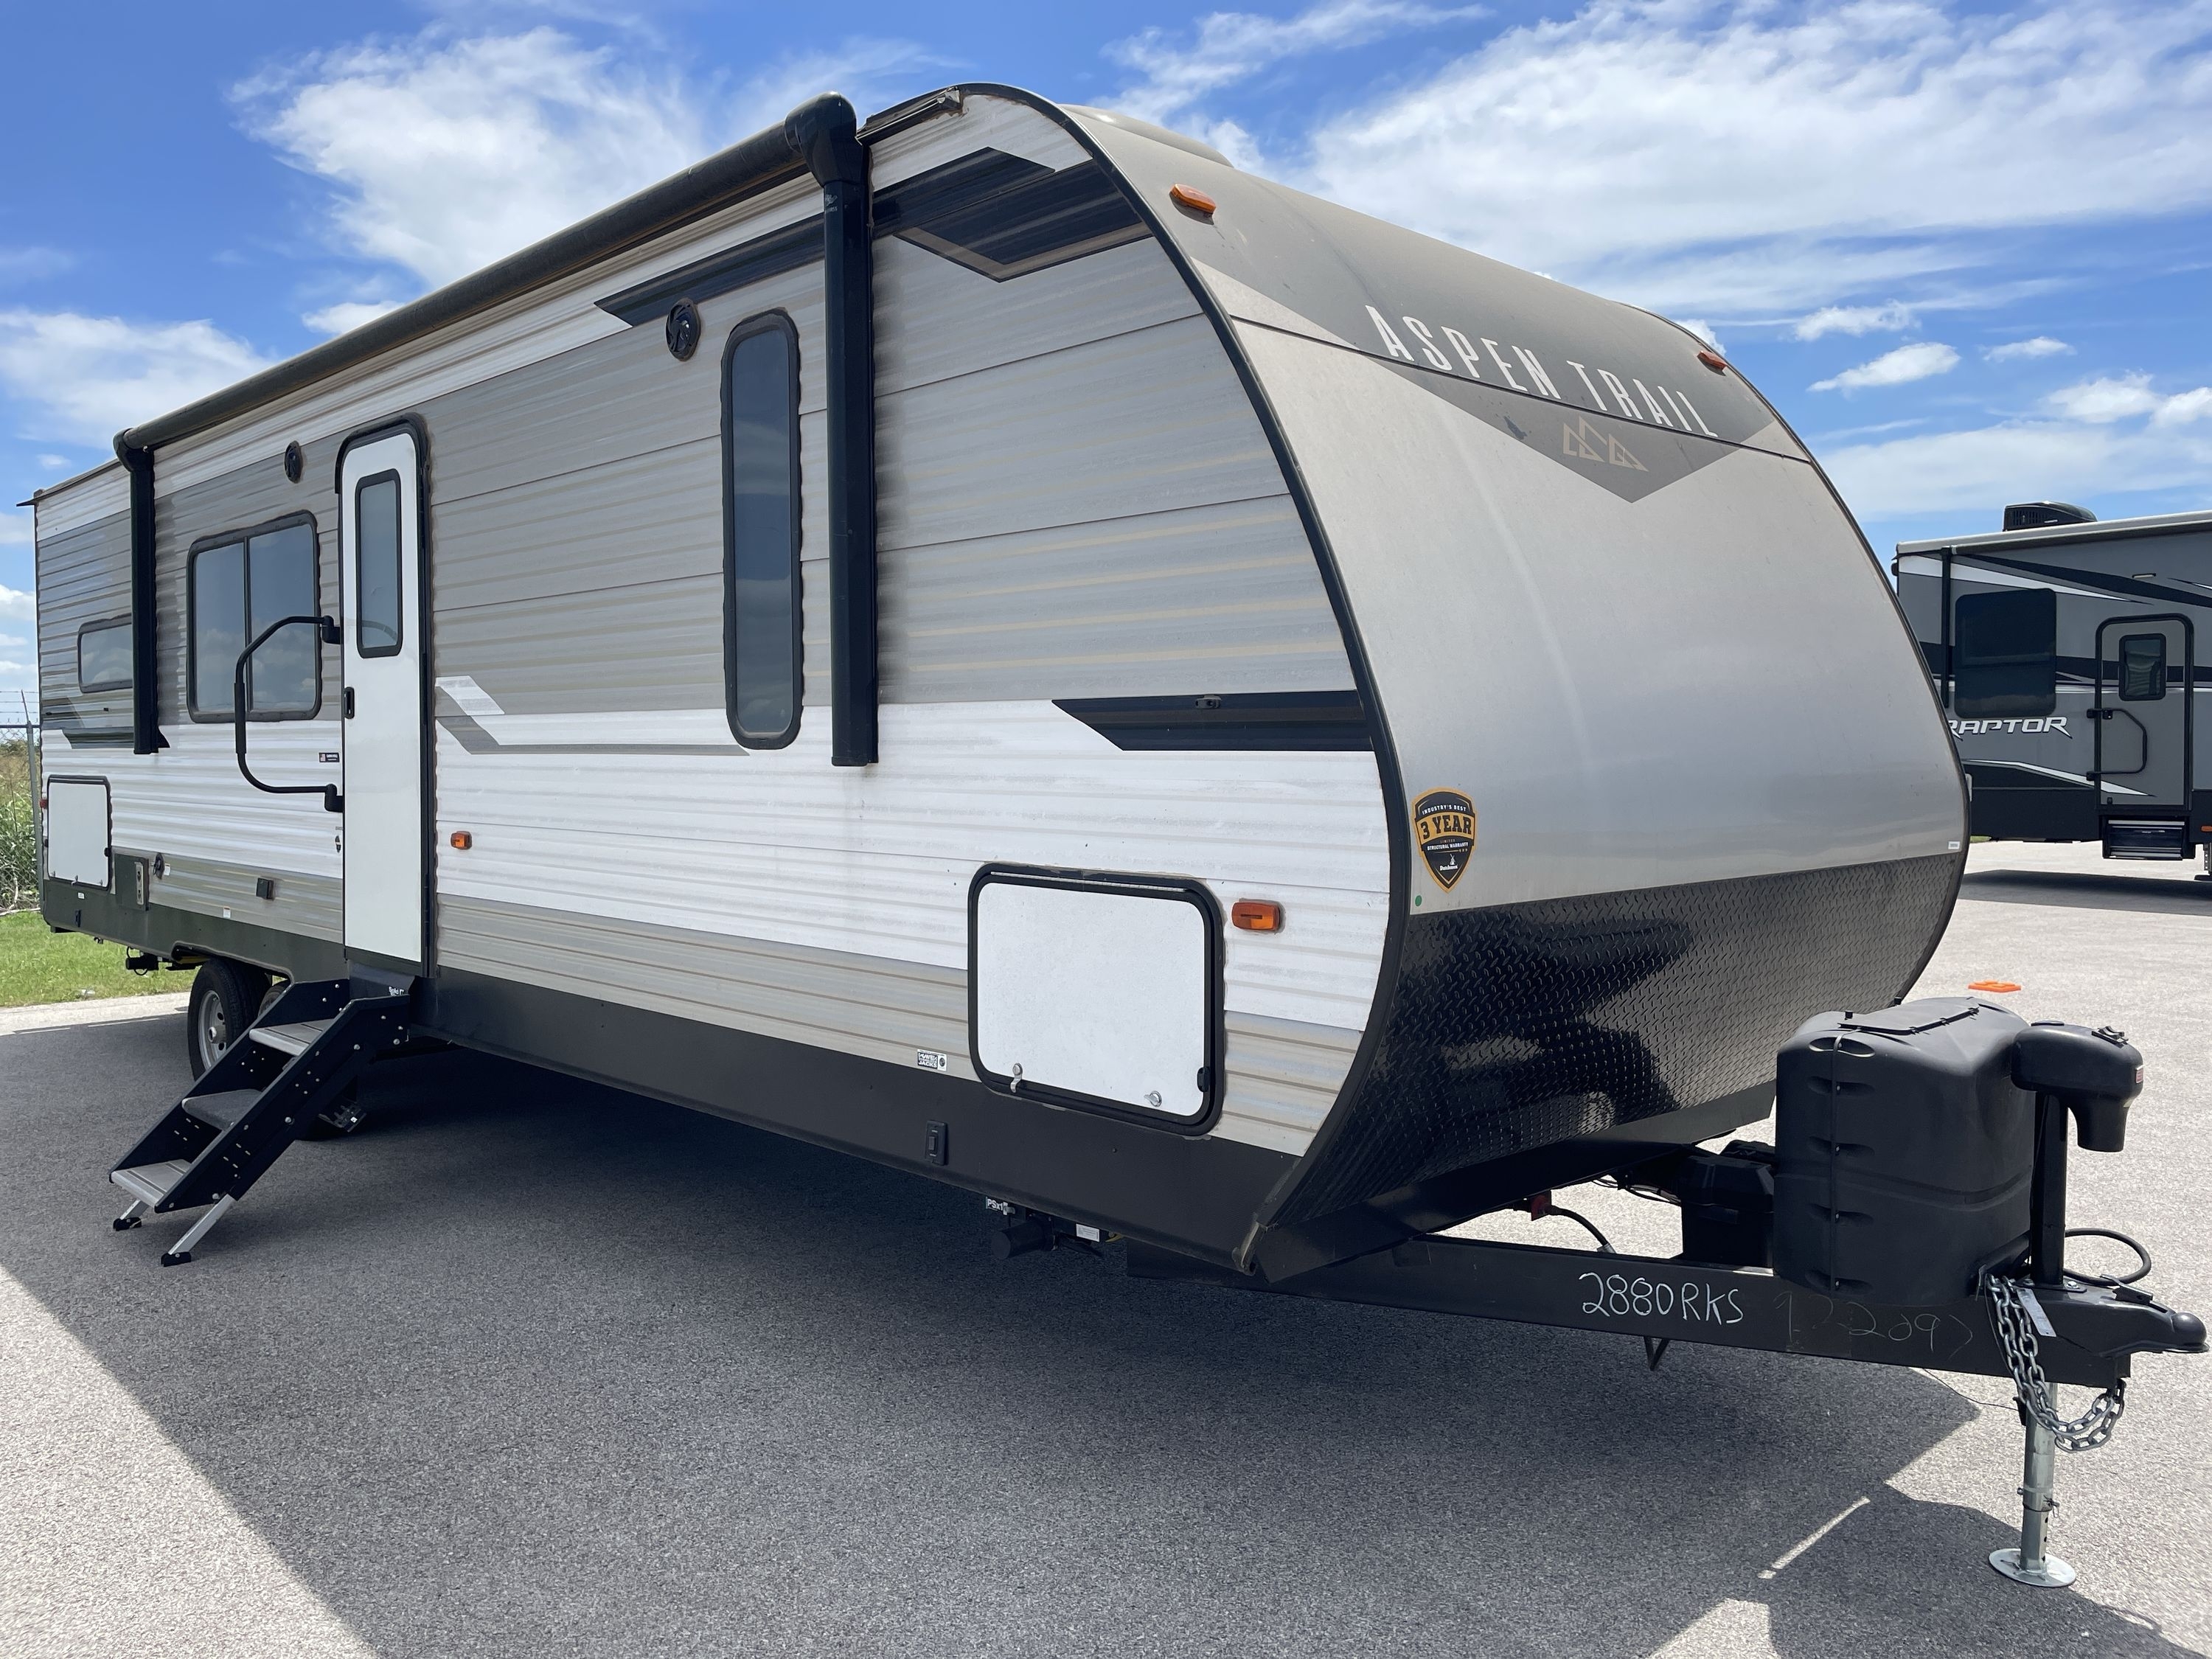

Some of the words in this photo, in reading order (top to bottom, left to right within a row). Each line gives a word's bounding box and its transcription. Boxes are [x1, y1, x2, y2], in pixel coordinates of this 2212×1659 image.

[1365, 305, 1562, 400] ASPEN
[1566, 360, 1718, 437] TRAIL
[1948, 717, 2073, 741] RAPTOR
[1422, 804, 1452, 815] INDUSTRY'S
[1420, 821, 1430, 840] 3
[1432, 815, 1472, 835] YEAR
[918, 1060, 938, 1068] JACKS
[1579, 1272, 1744, 1325] 2880RKS
